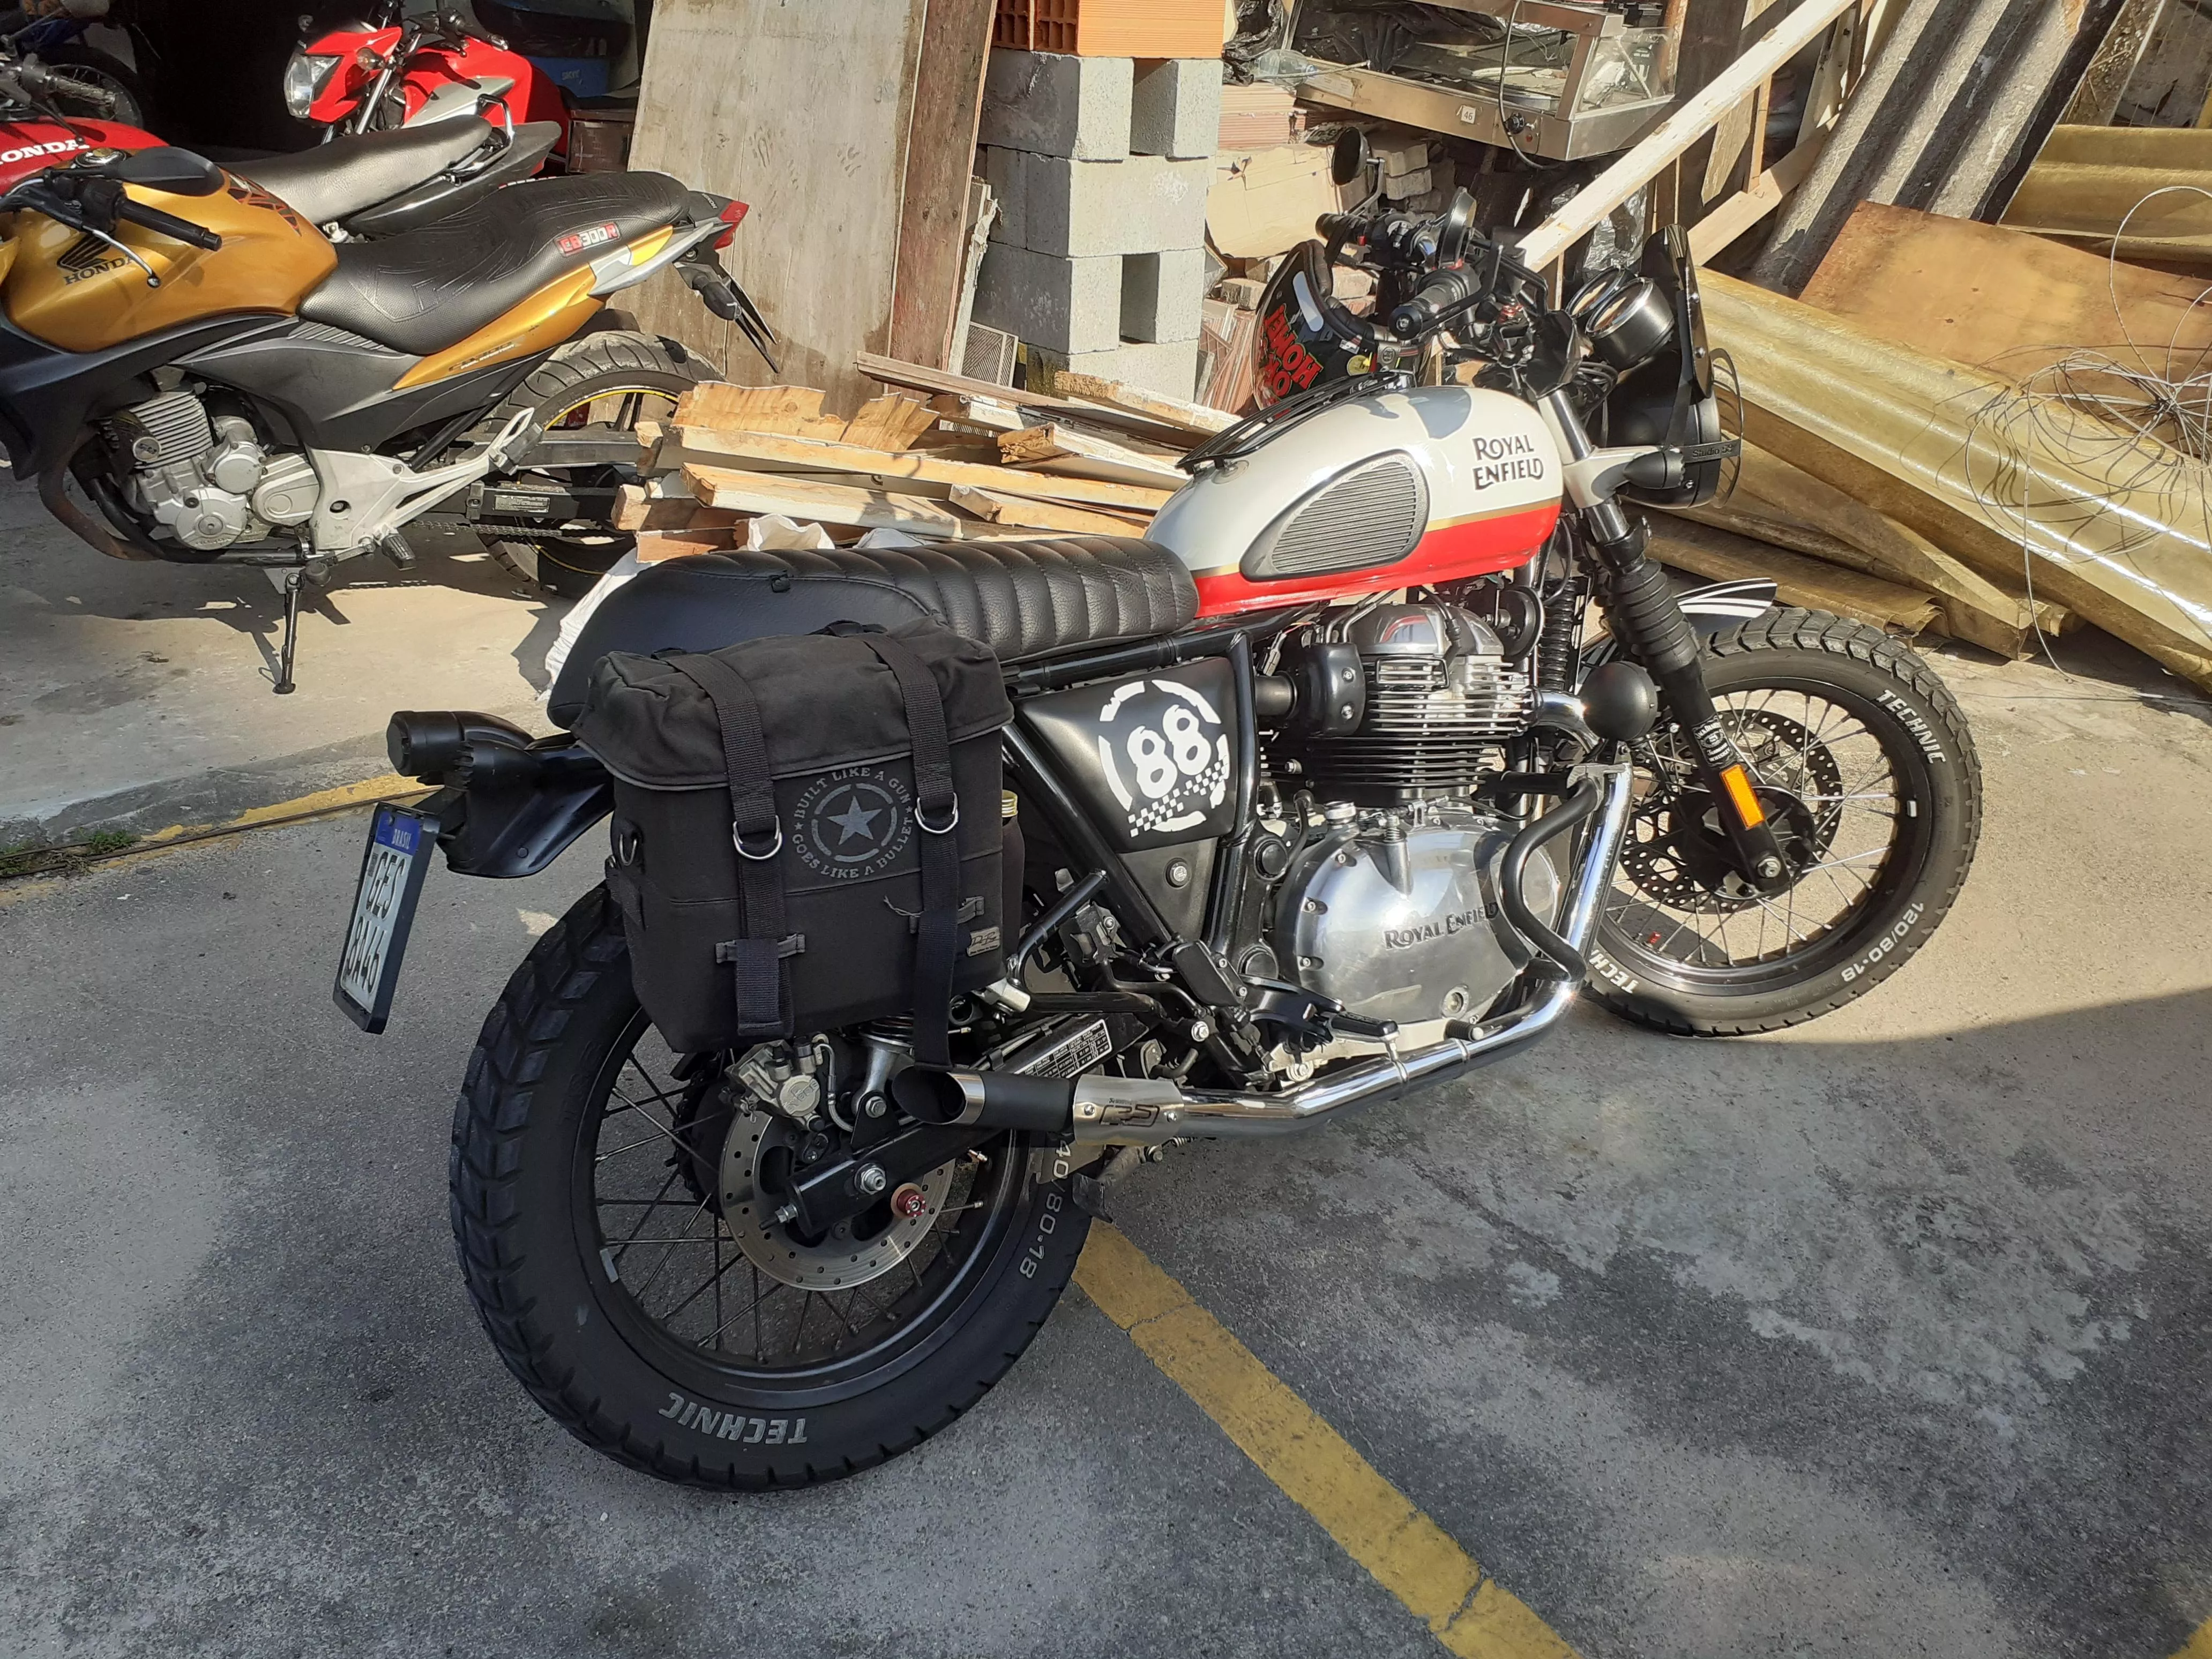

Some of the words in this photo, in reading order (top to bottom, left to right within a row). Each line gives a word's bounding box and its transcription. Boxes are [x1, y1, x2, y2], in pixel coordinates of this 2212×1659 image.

[1464, 111, 1473, 121] 46
[0, 139, 90, 165] ONDA
[559, 223, 619, 253] CB300R
[1472, 435, 1534, 460] ROYAL
[1692, 447, 1720, 458] Studio
[1472, 458, 1544, 490] ENFIELD
[1875, 689, 1946, 764] TECHNIC
[1127, 704, 1212, 798] 88
[794, 778, 828, 819] BUILT
[832, 767, 871, 781] LIKE
[875, 771, 884, 781] A
[888, 778, 911, 803] GUN
[391, 828, 412, 850] BRASIL
[792, 834, 820, 869] GOES
[820, 865, 860, 878] LIKE
[864, 865, 875, 876] A
[876, 817, 913, 868] BULLET
[366, 851, 406, 920] GES
[1384, 922, 1444, 950] ROYAL
[1446, 901, 1499, 935] ENFIELD
[347, 916, 387, 993] 8A46
[1588, 949, 1639, 994] TECH
[657, 1392, 808, 1445] TECHNIC
